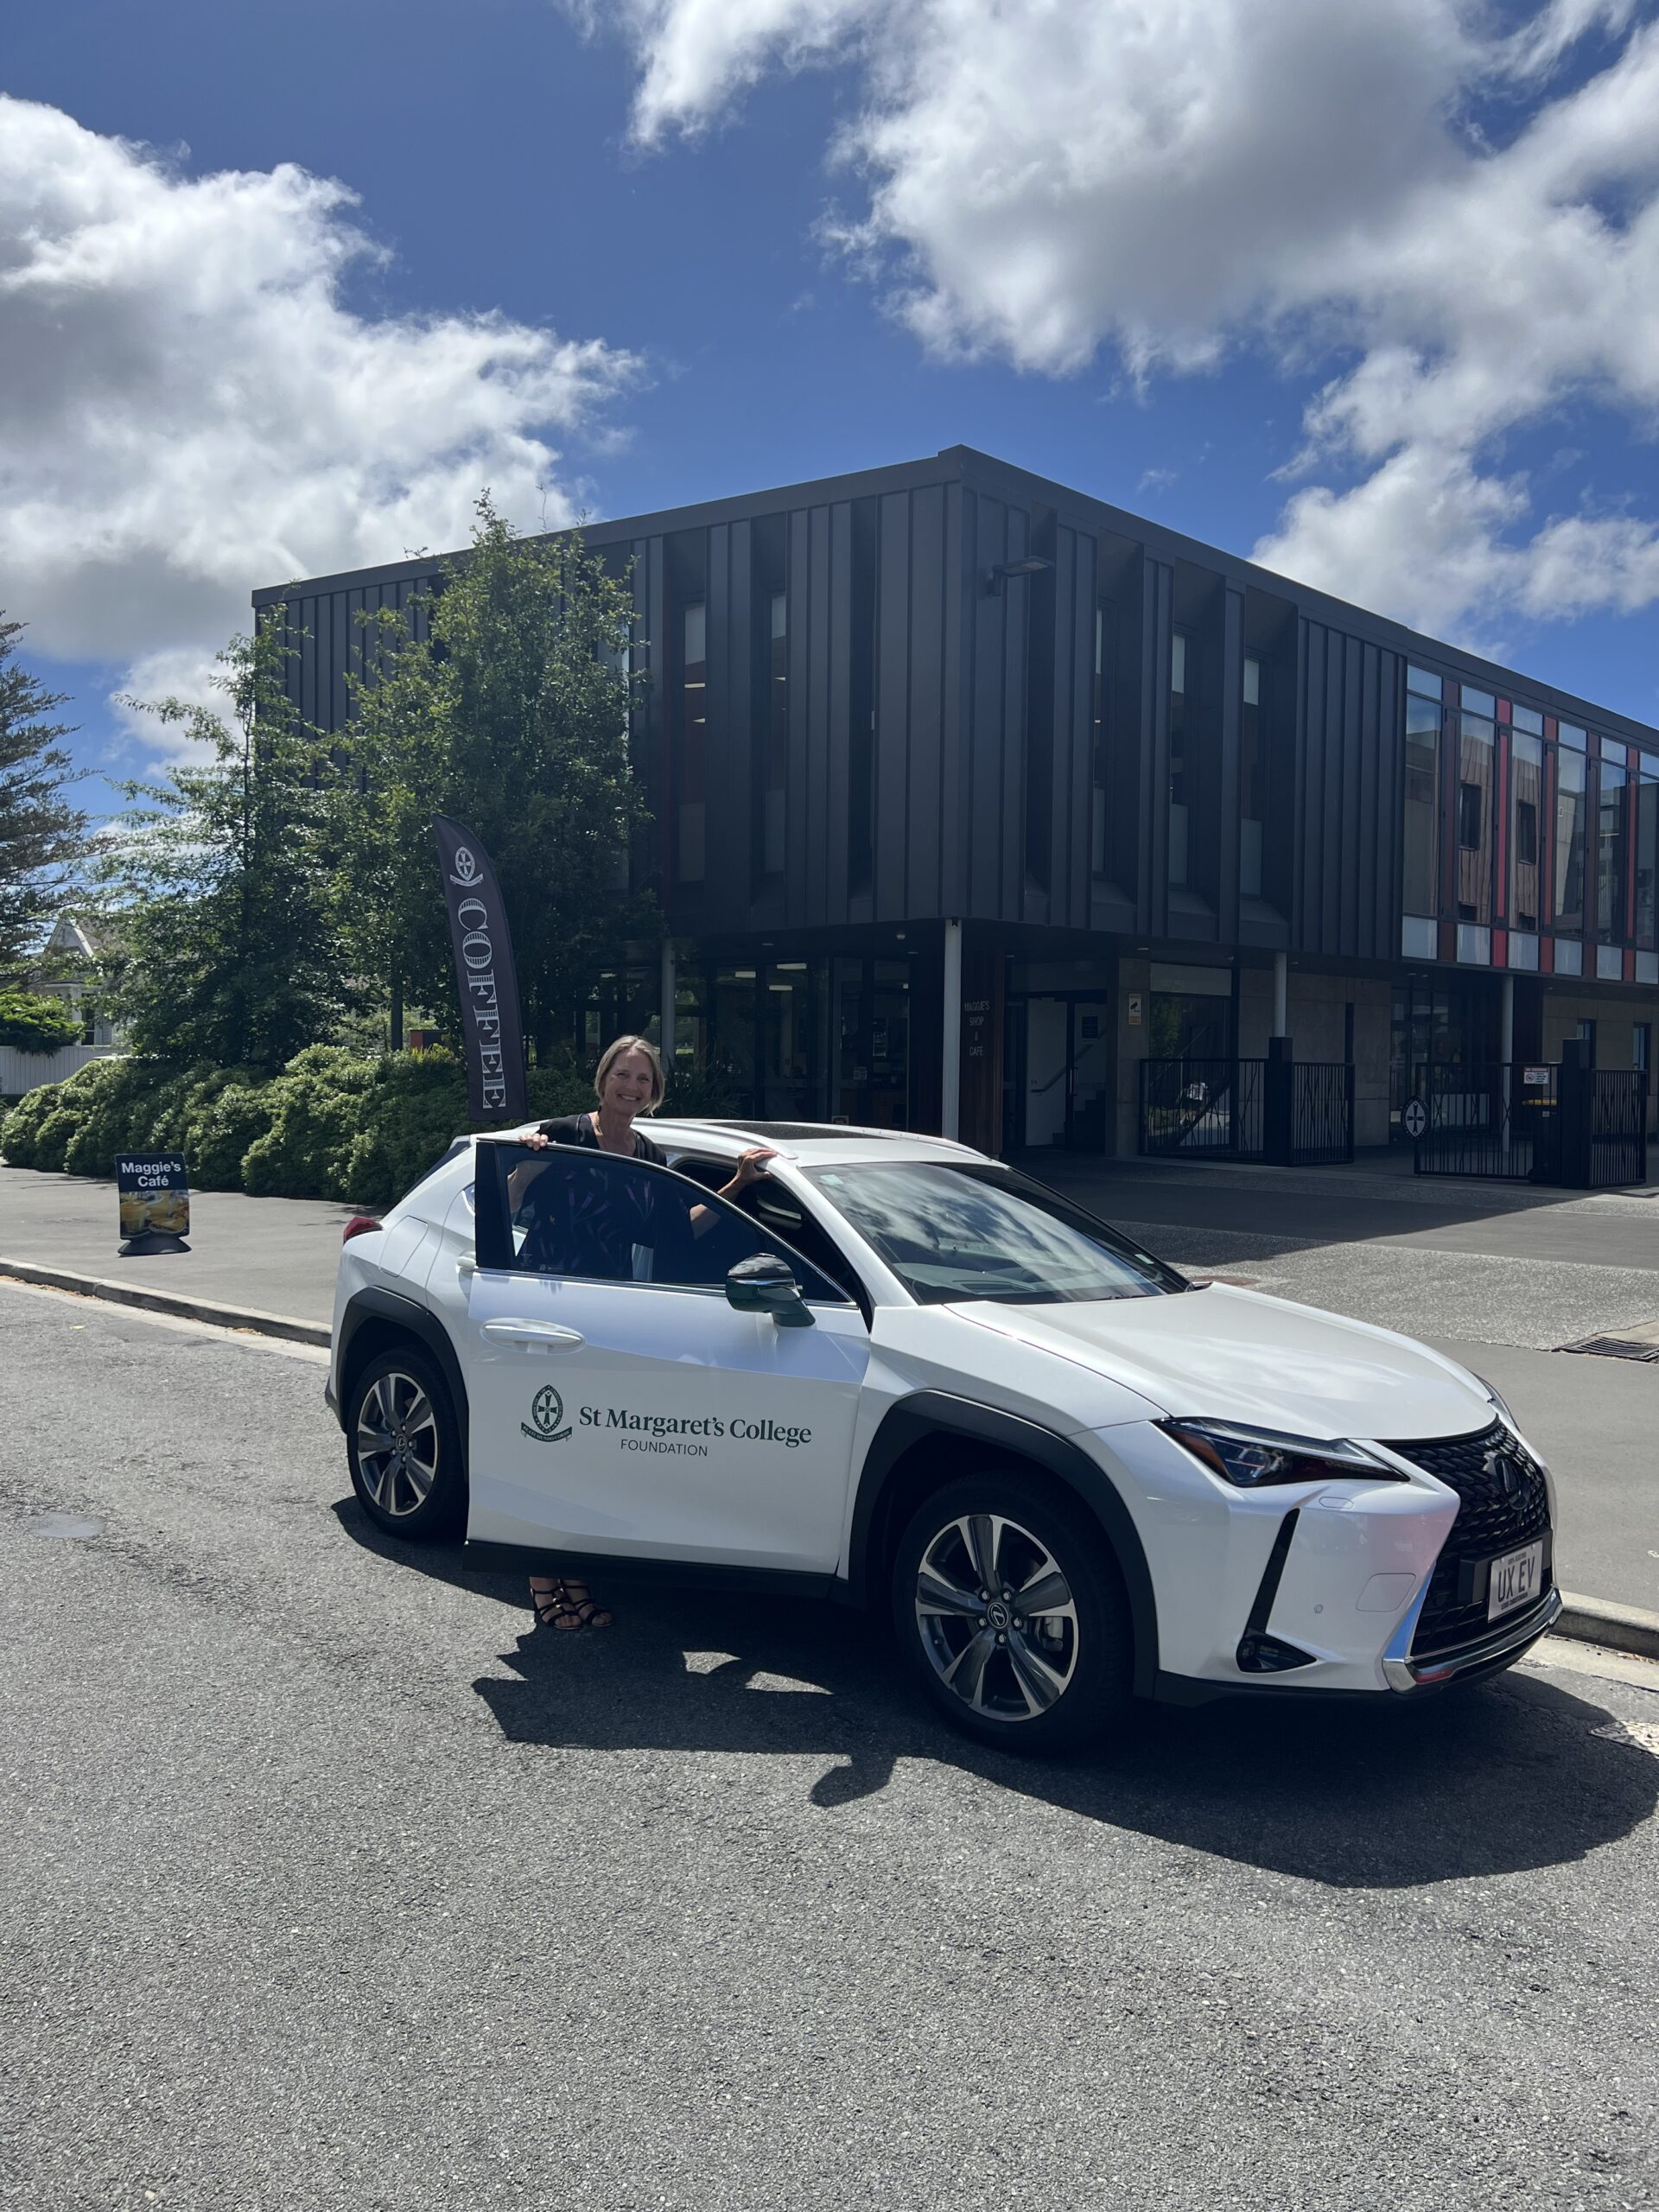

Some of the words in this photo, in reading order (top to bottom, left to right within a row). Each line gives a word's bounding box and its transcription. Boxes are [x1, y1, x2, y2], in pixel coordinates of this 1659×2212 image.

[457, 898, 506, 1109] COFFEE
[969, 1016, 984, 1027] SHOP
[121, 1161, 181, 1175] Maggie's
[137, 1175, 169, 1187] Café
[579, 1406, 602, 1427] St
[605, 1408, 725, 1437] Margaret's
[729, 1419, 812, 1448] College
[620, 1439, 708, 1457] FOUNDATION
[1498, 1565, 1515, 1602] UX
[1518, 1556, 1535, 1592] EV
